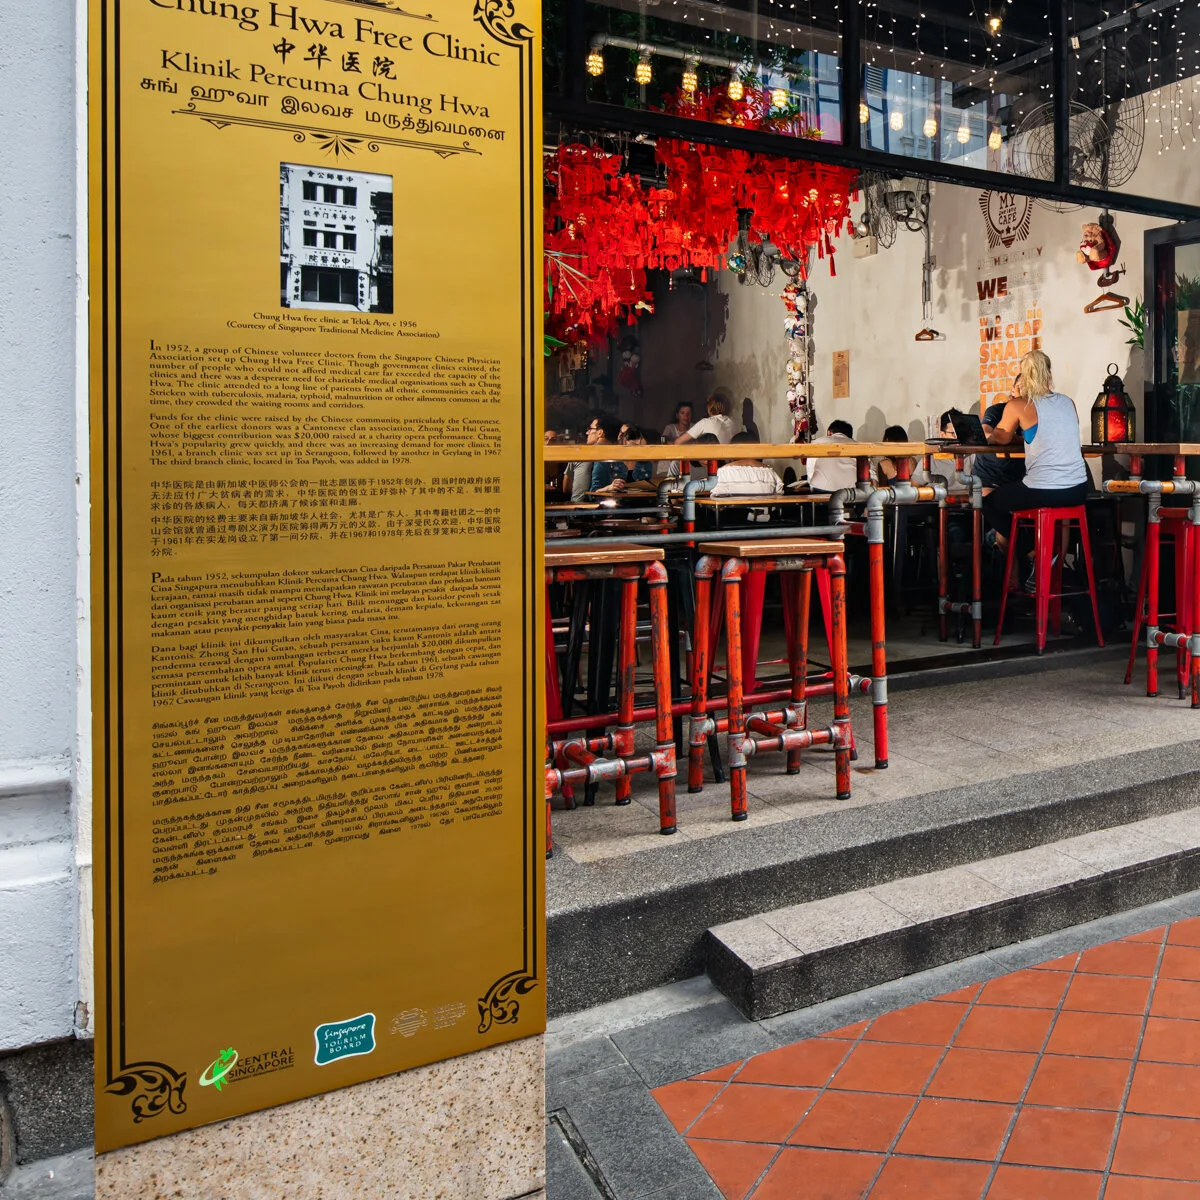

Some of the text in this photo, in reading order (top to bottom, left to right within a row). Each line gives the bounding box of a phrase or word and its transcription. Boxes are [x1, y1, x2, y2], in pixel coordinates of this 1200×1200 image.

[269, 1, 343, 39] Hwa
[354, 17, 412, 51] Free
[422, 28, 500, 67] Clinic
[273, 35, 396, 82] 中华医院
[161, 48, 489, 118] Klinik Percuma Chung Hwa
[281, 95, 353, 121] இலவச
[253, 311, 279, 321] Chung
[282, 313, 300, 321] Hwa
[303, 314, 317, 322] free
[350, 317, 370, 325] Telok
[399, 320, 417, 328] 1956
[277, 323, 316, 333] Singapore
[318, 325, 358, 333] Traditional
[361, 327, 394, 335] Medicine
[980, 319, 1042, 342] WE CLAP
[324, 1022, 366, 1040] Singapore
[325, 1033, 367, 1049] TOURISM
[237, 1047, 295, 1068] CENTRAL
[329, 1041, 362, 1054] BOARD
[229, 1055, 295, 1079] SINGAPORE
